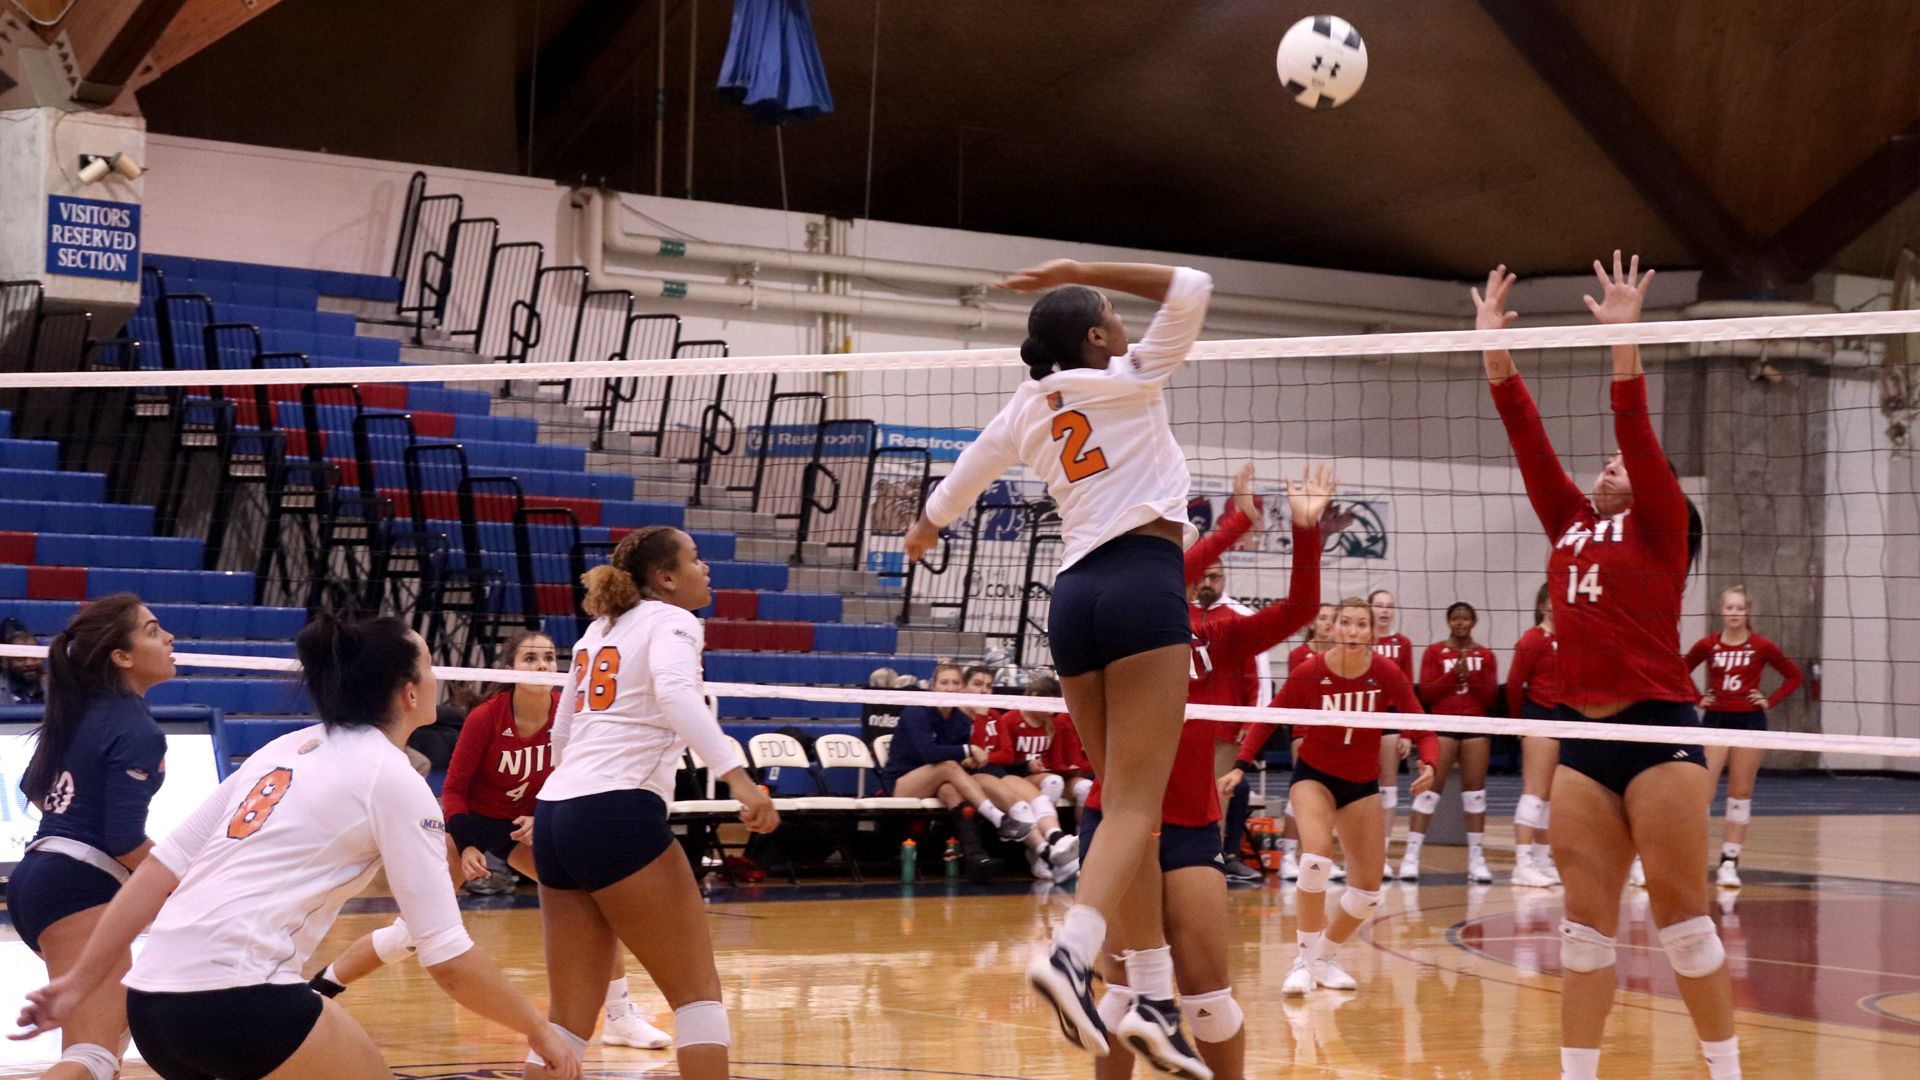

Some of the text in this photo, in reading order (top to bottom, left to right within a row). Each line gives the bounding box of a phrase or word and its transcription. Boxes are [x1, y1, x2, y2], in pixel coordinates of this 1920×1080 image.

[59, 202, 131, 228] VISITORS
[52, 224, 137, 251] RESERVED
[58, 248, 128, 272] SECTION
[888, 433, 976, 452] Restroo
[1051, 409, 1109, 484] 2
[1567, 563, 1603, 604] 14
[1712, 650, 1756, 672] NJIT
[574, 645, 621, 713] 28
[1722, 673, 1742, 691] 16
[758, 740, 798, 758] FDU
[825, 740, 864, 759] FDU
[226, 766, 293, 840] 8
[505, 781, 530, 802] 4
